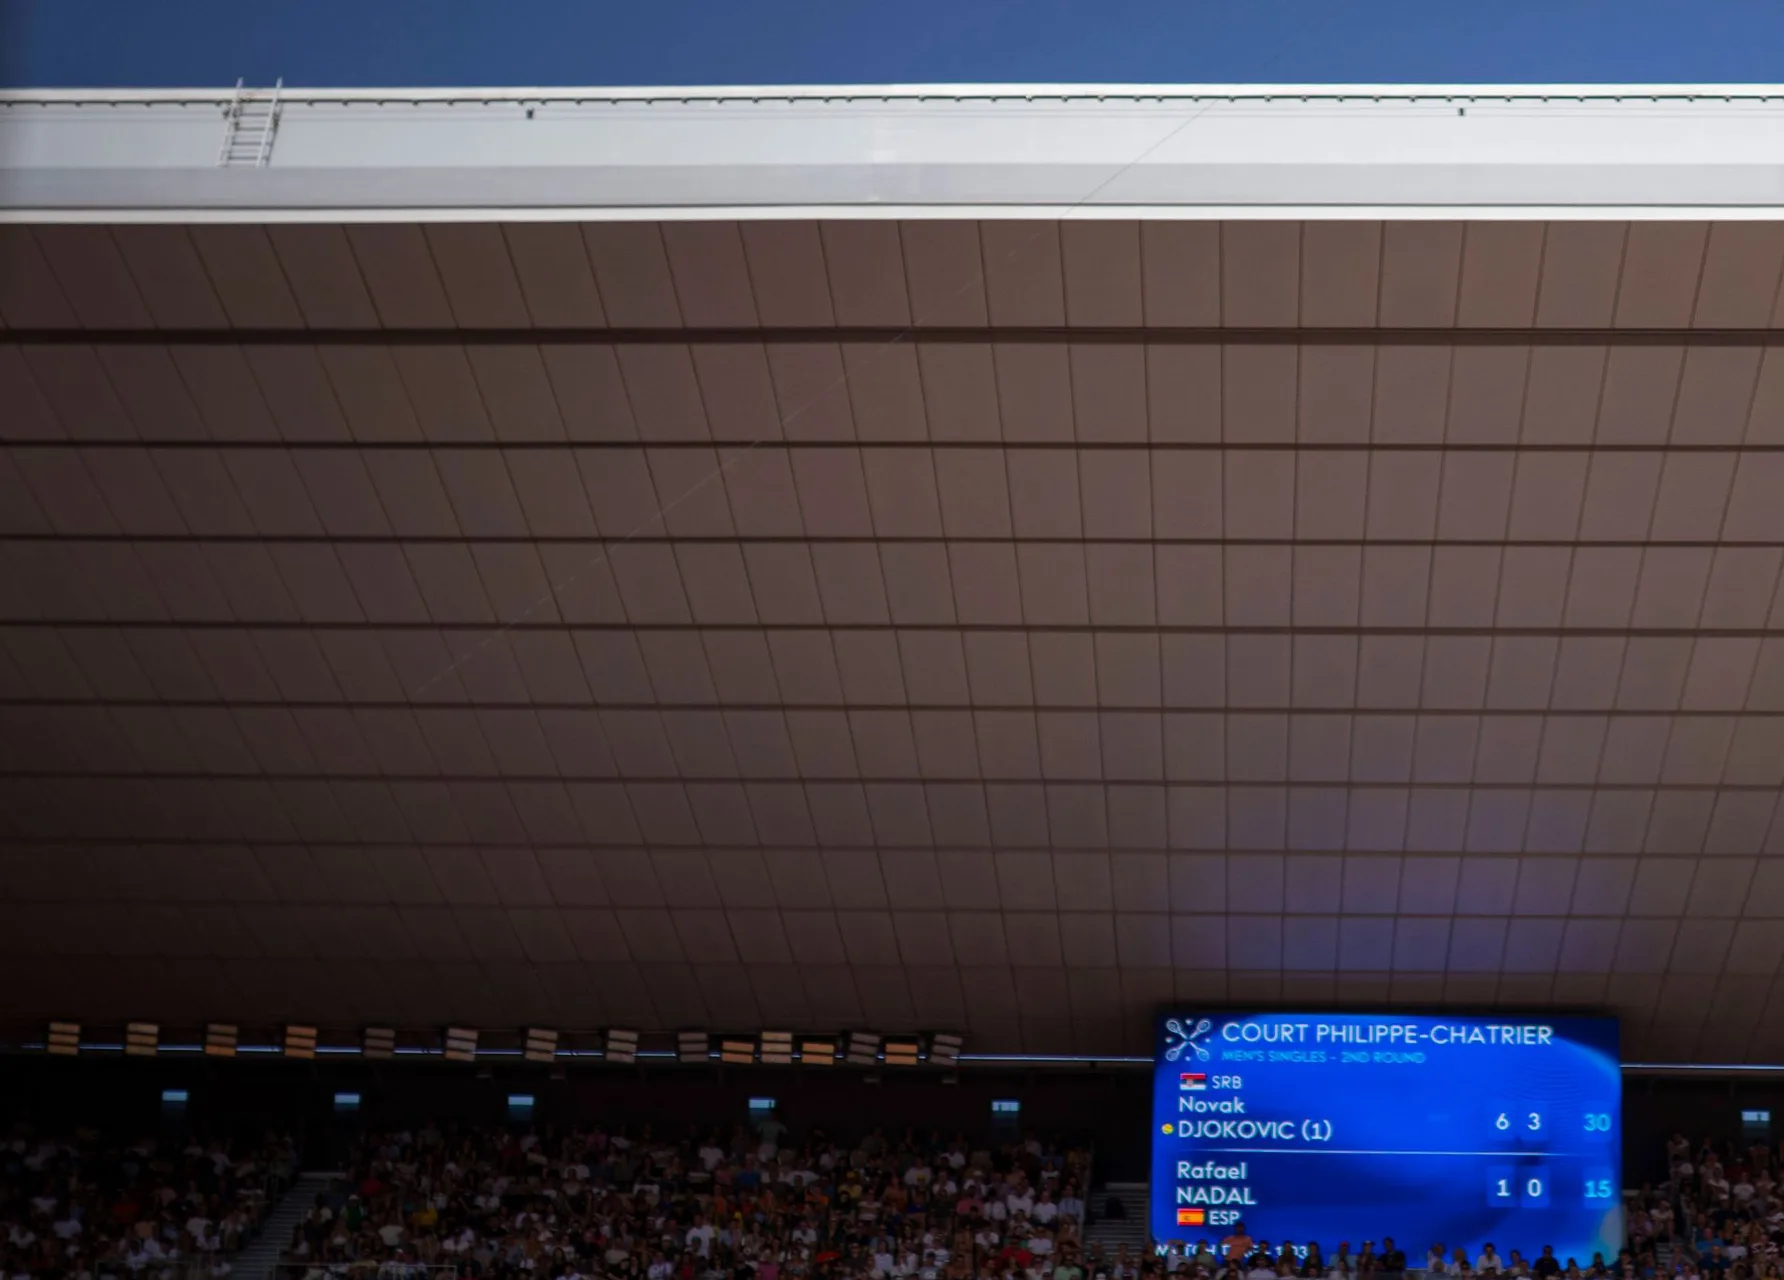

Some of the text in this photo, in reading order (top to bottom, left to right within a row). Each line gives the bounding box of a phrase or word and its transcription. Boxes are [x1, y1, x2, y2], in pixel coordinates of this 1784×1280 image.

[1222, 1022, 1554, 1046] COURT PHILIPPE-CHATRIER
[1222, 1050, 1265, 1062] MEN'S
[1268, 1051, 1327, 1063] SINGLES
[1341, 1052, 1371, 1064] 2ND
[1373, 1052, 1426, 1064] ROUND
[1212, 1075, 1242, 1089] SRB
[1179, 1096, 1245, 1113] Novak
[1178, 1119, 1333, 1141] DJOKOVIC (1)
[1496, 1113, 1612, 1132] 6 3 30
[1177, 1161, 1247, 1180] Rafael
[1176, 1186, 1258, 1205] NADAL
[1496, 1178, 1612, 1198] 1 0 15
[1209, 1210, 1240, 1225] ESP
